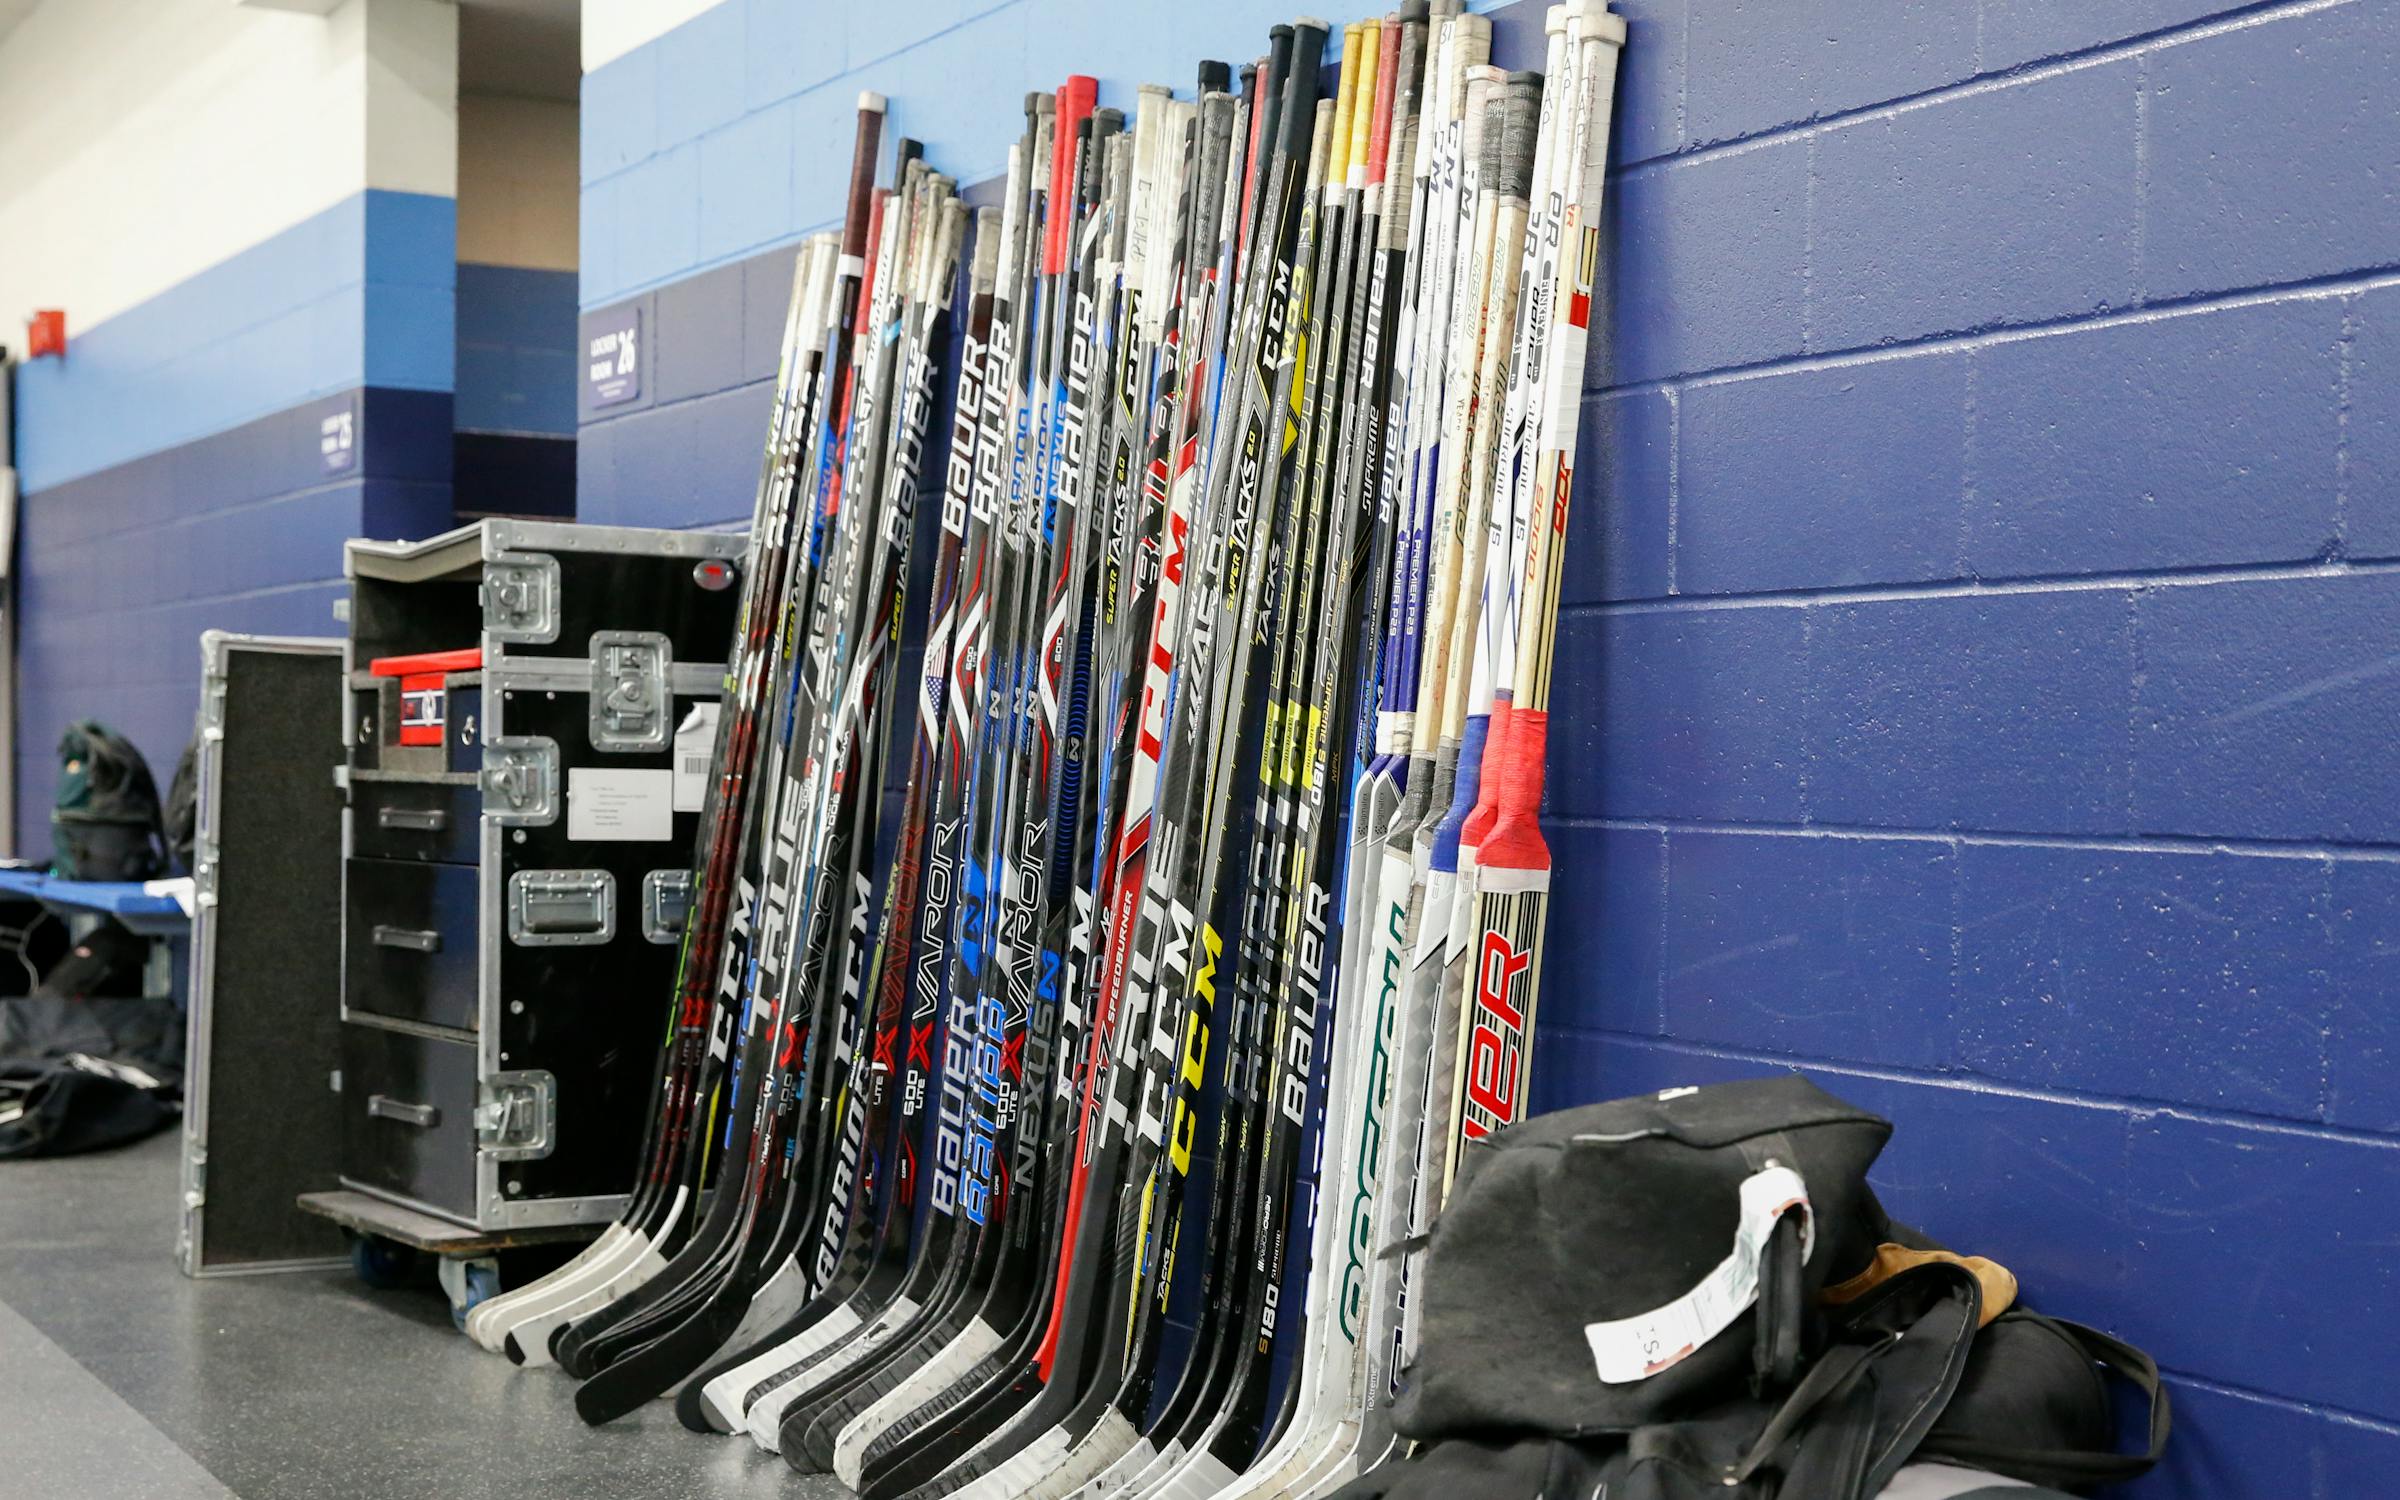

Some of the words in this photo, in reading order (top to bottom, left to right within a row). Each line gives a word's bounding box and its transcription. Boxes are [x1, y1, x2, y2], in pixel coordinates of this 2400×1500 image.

[1541, 66, 1555, 134] HAP
[1263, 258, 1290, 371] CCM
[1281, 264, 1305, 358] CCM
[1466, 251, 1482, 339] PASSAU
[1538, 278, 1550, 325] FUNKEY
[617, 328, 636, 376] 26
[1536, 331, 1544, 346] 33
[1107, 483, 1127, 567] TACKS
[1229, 455, 1257, 552] TACKS
[1106, 568, 1119, 625] SUPER
[1226, 554, 1241, 612] SUPER
[1246, 527, 1265, 592] TACKS
[1255, 537, 1281, 647] TACKS
[1393, 540, 1406, 604] PREMIER
[1409, 538, 1422, 603] PREMIER
[1140, 511, 1188, 763] CCM
[1309, 747, 1328, 807] S180
[789, 833, 849, 1024] VAPOR
[912, 815, 961, 1021] VAPOR
[1004, 817, 1048, 1030] VAPOR
[1107, 889, 1134, 1024] SPEEDBURNER
[707, 876, 756, 1064] CCM
[834, 870, 873, 1065] CCM
[1056, 884, 1094, 1102] CCM
[1099, 814, 1181, 1150] TRUE
[1137, 898, 1195, 1148] CCM
[1169, 921, 1224, 1178] CCM
[777, 1073, 793, 1117] 900
[873, 1075, 884, 1106] LITE
[903, 1069, 918, 1116] 600
[915, 1078, 926, 1111] LITE
[995, 1081, 1011, 1130] 600
[1008, 1090, 1019, 1123] LITE
[1016, 1002, 1055, 1189] NEXUS
[1157, 1247, 1171, 1301] TACKS
[1258, 1283, 1280, 1355] S180
